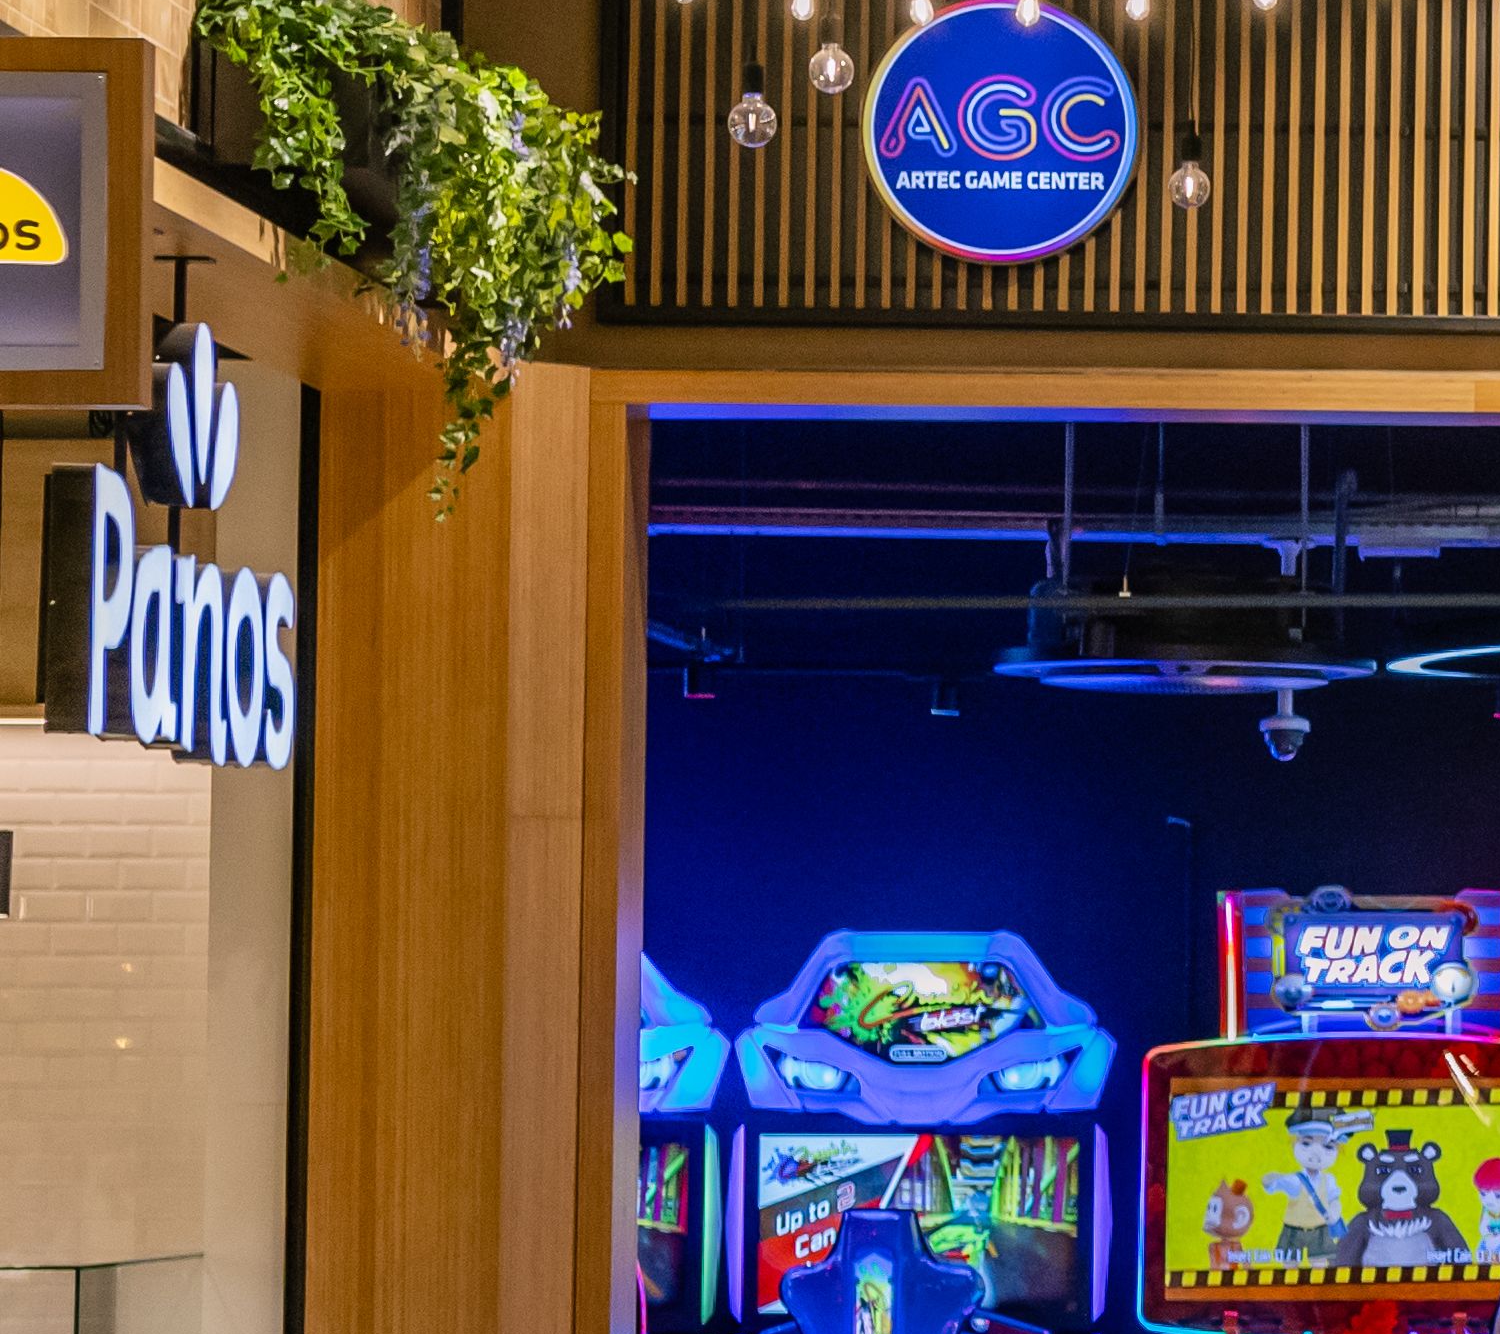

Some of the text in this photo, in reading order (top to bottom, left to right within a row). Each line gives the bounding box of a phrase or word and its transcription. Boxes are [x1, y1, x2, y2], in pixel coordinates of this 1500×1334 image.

[879, 73, 1121, 162] AGC
[895, 170, 1105, 191] ARTEC GAME CENTER
[89, 462, 298, 771] Panos
[1298, 924, 1451, 959] FUN ON
[1303, 949, 1437, 985] TRACK
[1171, 1084, 1276, 1121] FUN ON
[1176, 1105, 1265, 1137] TRACK
[775, 1210, 804, 1237] Up
[808, 1200, 831, 1223] to
